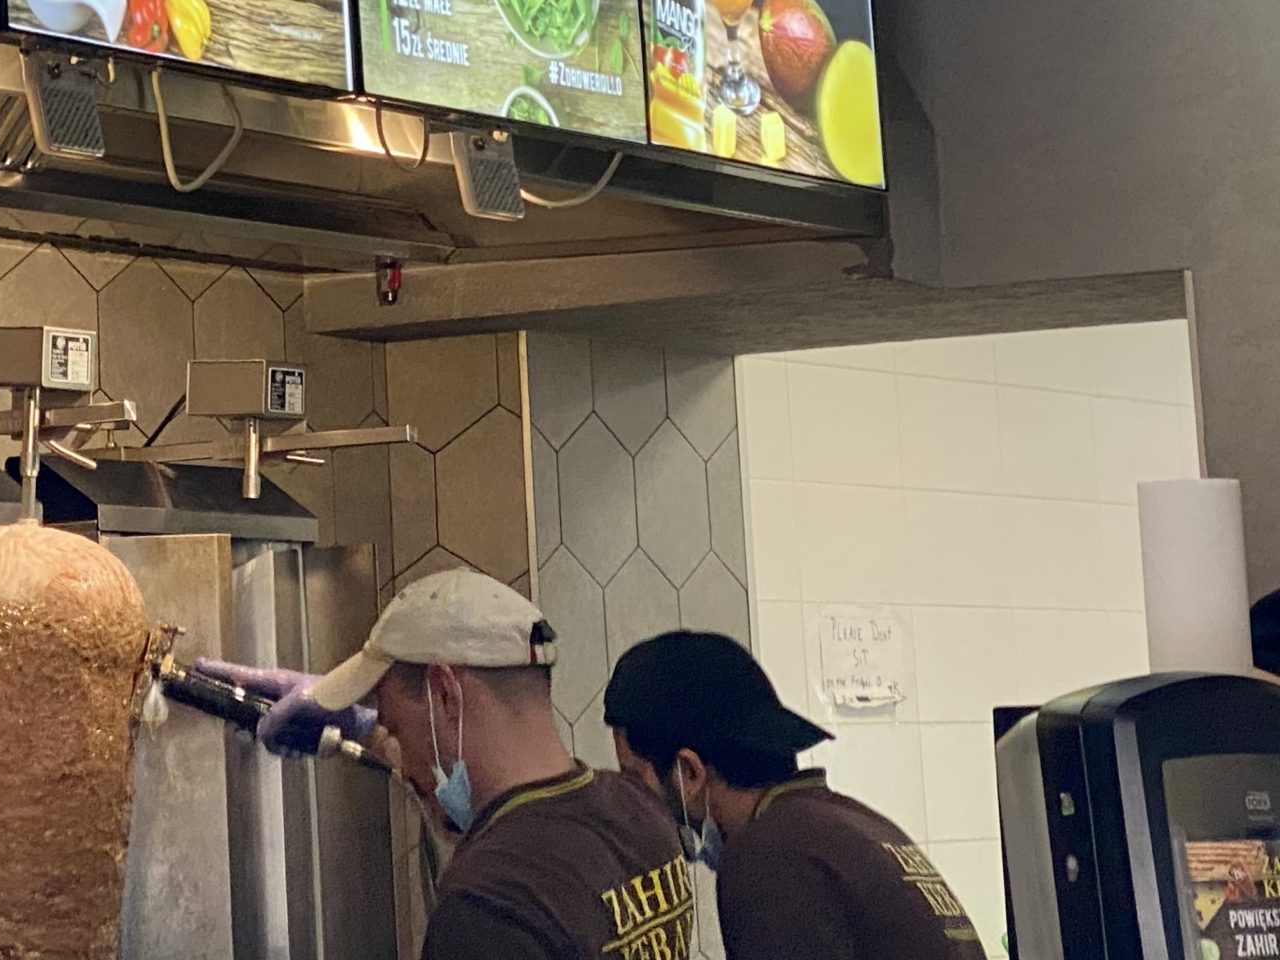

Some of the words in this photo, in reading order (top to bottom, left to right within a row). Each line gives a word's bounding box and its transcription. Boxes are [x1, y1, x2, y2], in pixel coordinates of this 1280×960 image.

[427, 31, 470, 67] ŚREDNIE
[601, 854, 692, 930] ZAHIR
[1229, 908, 1280, 931] POWIĘKS
[1235, 933, 1279, 957] ZAHIR
